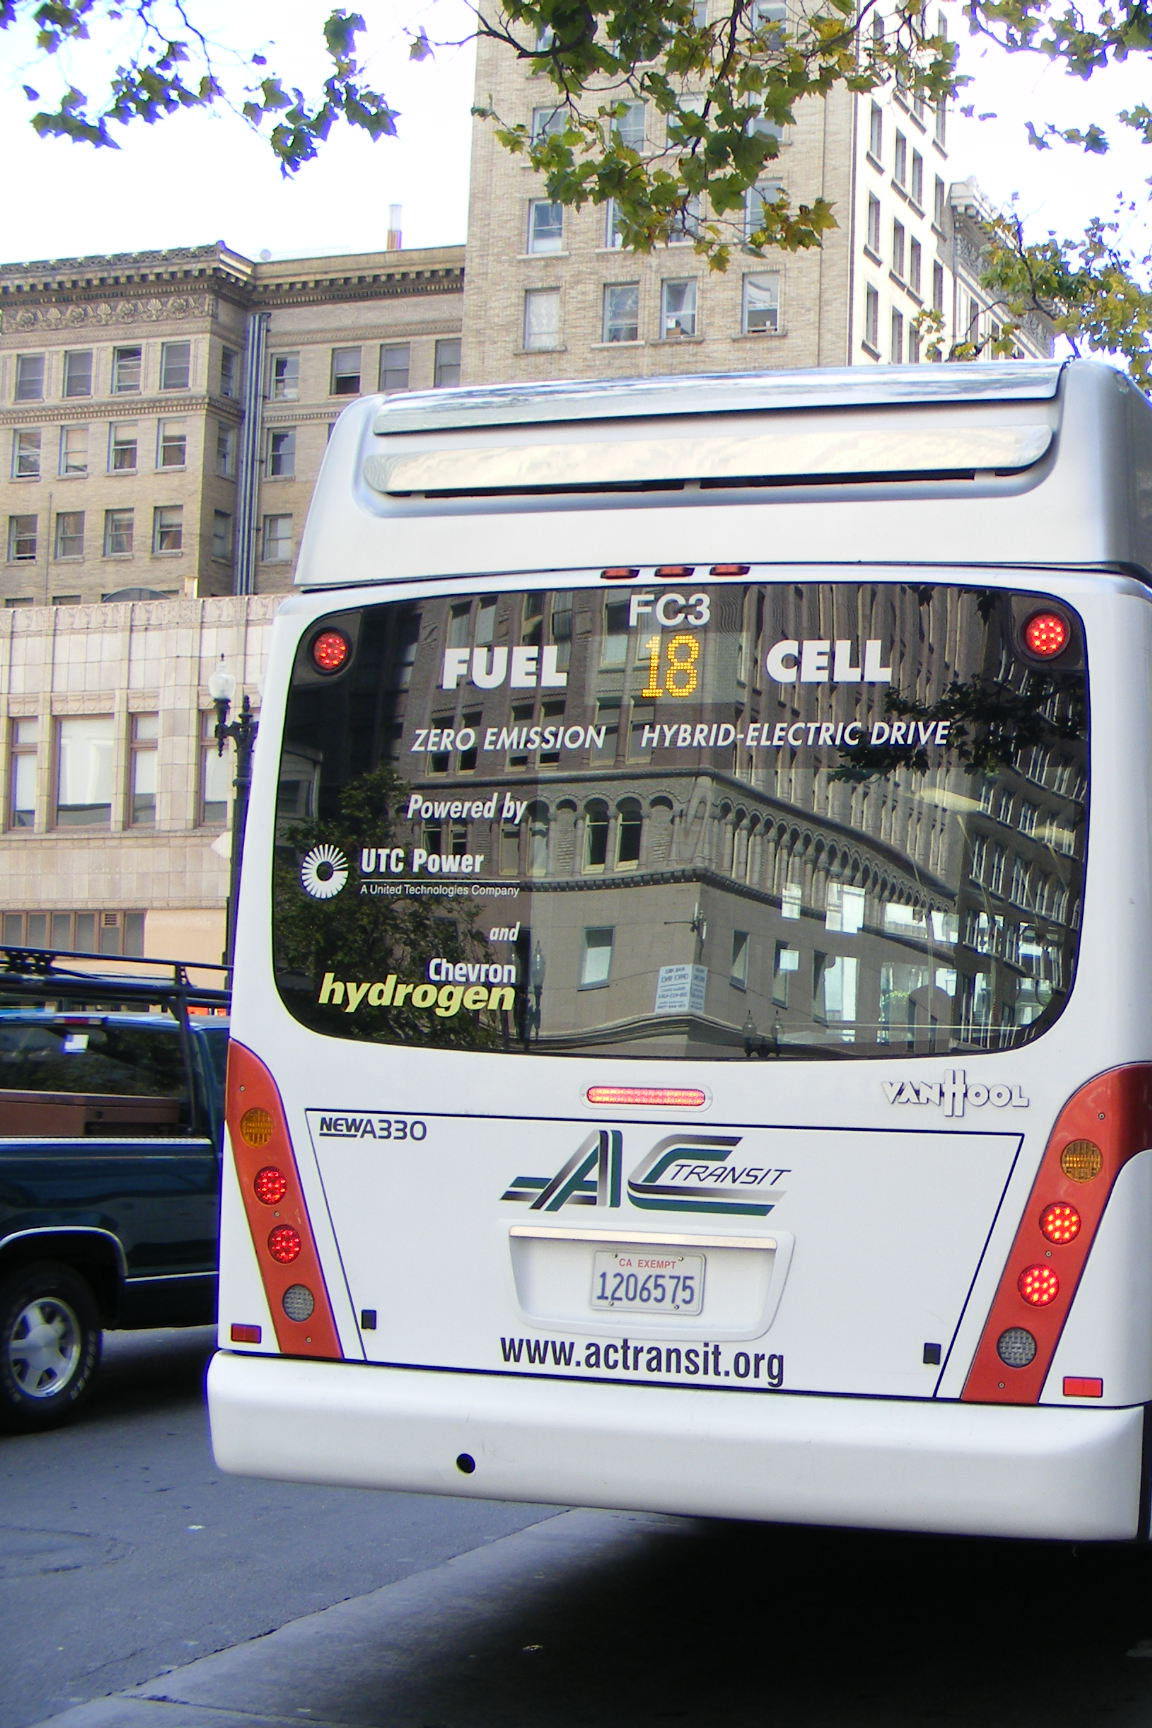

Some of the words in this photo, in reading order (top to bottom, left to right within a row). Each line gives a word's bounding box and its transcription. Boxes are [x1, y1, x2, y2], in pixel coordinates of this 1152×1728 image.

[629, 592, 711, 627] FC3
[442, 645, 568, 690] FUEL
[640, 633, 700, 698] 18
[765, 639, 893, 683] CELL
[411, 727, 477, 752] ZERO
[483, 725, 607, 750] EMISSION
[640, 721, 863, 748] HYBRID-ELECTRIC
[870, 720, 951, 746] DRIVE
[407, 792, 500, 819] Powered
[502, 791, 528, 825] by
[361, 848, 404, 874] UTC
[412, 848, 485, 874] Power
[360, 886, 368, 895] A
[370, 884, 402, 895] United
[404, 884, 469, 898] Technologies
[471, 884, 520, 898] Company
[489, 921, 521, 942] and
[428, 957, 517, 984] Chevron
[318, 972, 517, 1018] hydrogen
[500, 1129, 788, 1217] AC
[669, 1163, 792, 1187] TRANSIT
[618, 1257, 633, 1269] CA
[637, 1258, 678, 1270] EXEMPT
[596, 1271, 696, 1306] 1206575
[500, 1336, 785, 1388] www.actransit.org
